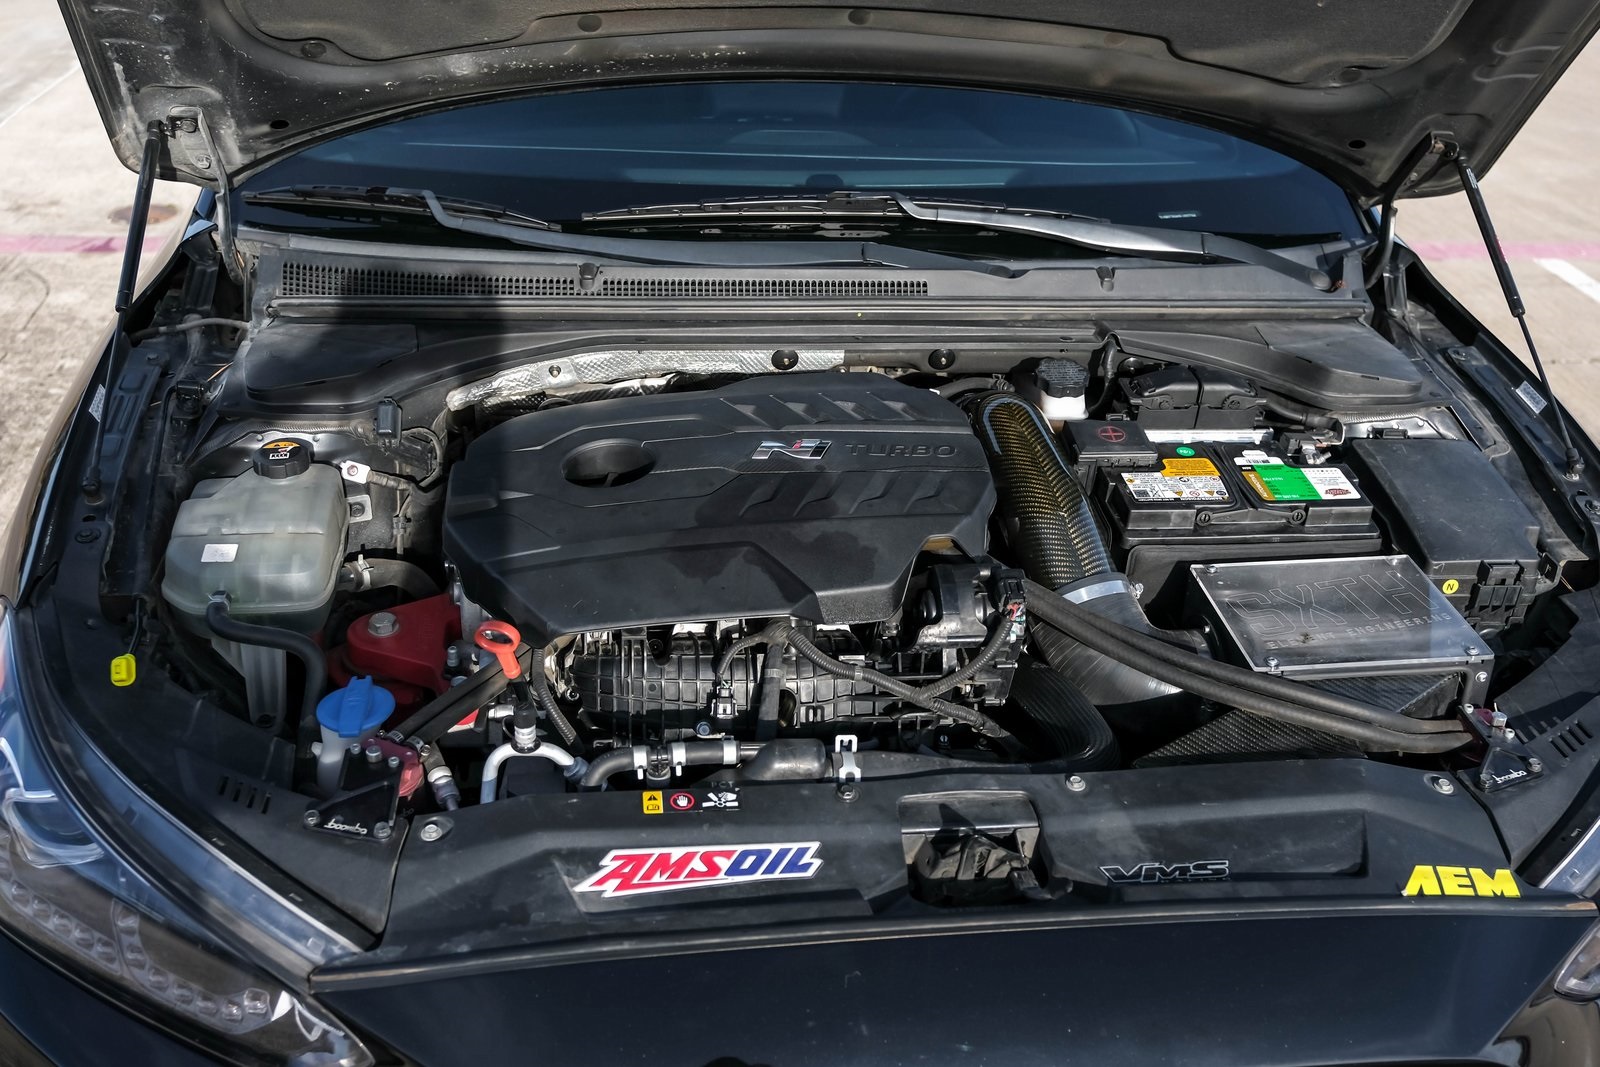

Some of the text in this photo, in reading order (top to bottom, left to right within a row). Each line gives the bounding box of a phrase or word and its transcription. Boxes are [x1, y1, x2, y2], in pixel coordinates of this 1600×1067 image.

[846, 444, 957, 458] TURBO
[1348, 613, 1451, 636] ENGINEERING
[589, 847, 814, 892] AMSOIL
[1100, 860, 1229, 883] VMS
[1405, 865, 1521, 898] AEM
